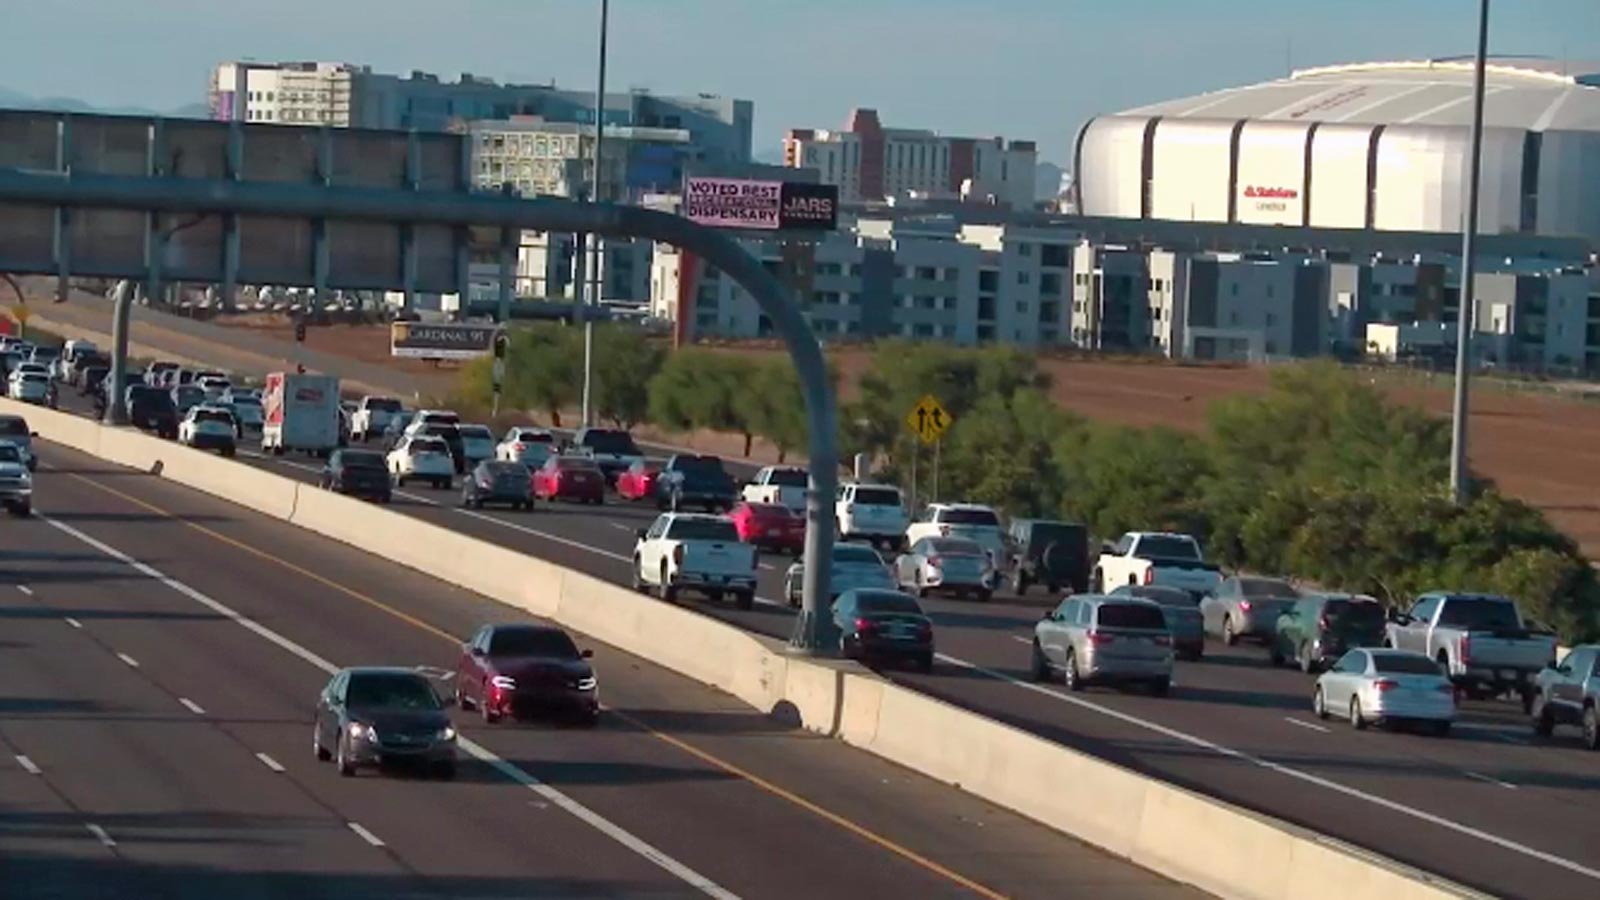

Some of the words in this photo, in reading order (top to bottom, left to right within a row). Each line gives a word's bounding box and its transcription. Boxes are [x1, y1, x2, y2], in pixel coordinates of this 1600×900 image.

[690, 182, 738, 195] VOTED
[742, 186, 778, 198] BEST
[784, 197, 832, 212] JARS
[689, 206, 777, 221] DISPENSARY
[409, 329, 467, 341] CARDINAL
